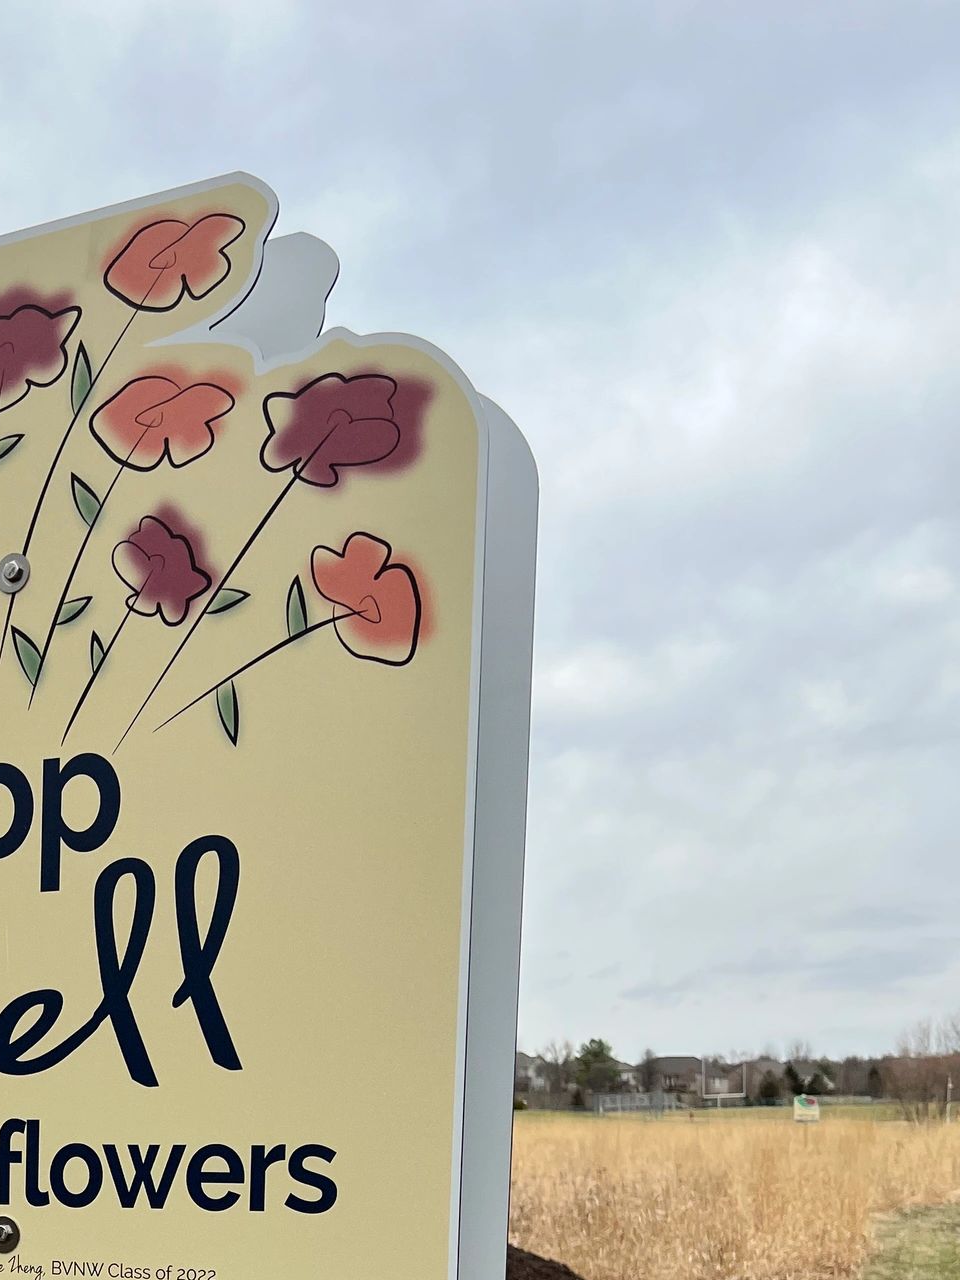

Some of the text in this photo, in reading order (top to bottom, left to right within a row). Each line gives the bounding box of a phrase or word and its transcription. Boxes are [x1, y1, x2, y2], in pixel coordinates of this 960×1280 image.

[51, 1260, 105, 1277] BVNW
[107, 1263, 151, 1280] Class
[155, 1265, 173, 1280] of
